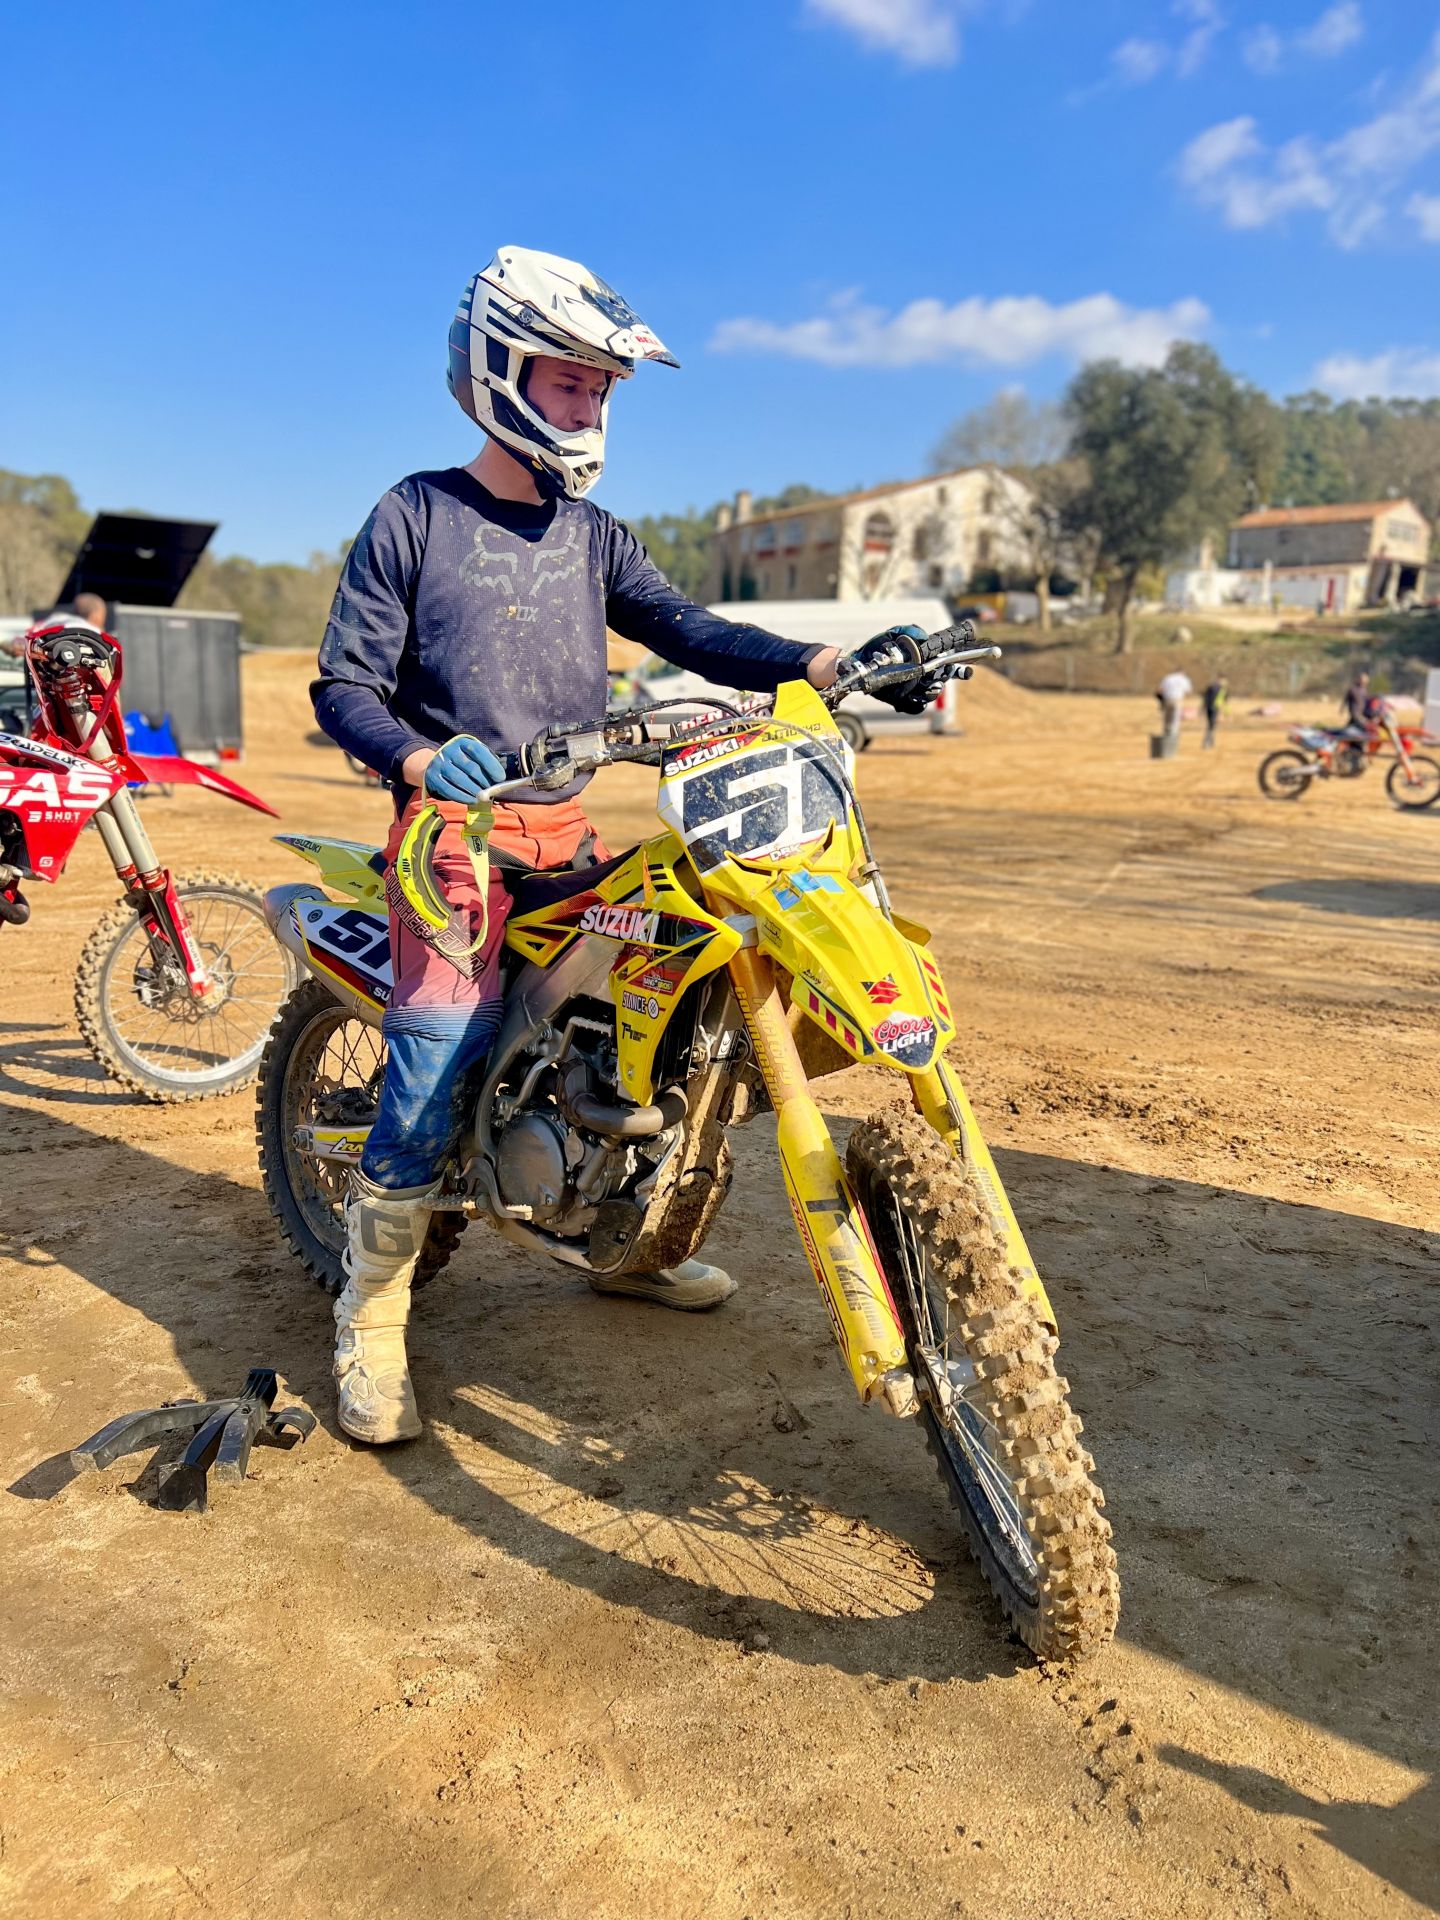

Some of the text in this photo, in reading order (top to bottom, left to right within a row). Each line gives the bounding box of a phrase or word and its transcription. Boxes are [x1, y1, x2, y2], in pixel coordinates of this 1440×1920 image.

[664, 738, 739, 777] SUZUKI
[45, 811, 81, 821] SHOT
[293, 838, 322, 854] SUZUKI
[580, 905, 660, 943] SUZUKI
[622, 991, 646, 1014] STANCE
[873, 1015, 932, 1043] Coors
[882, 1030, 934, 1053] LIGHT
